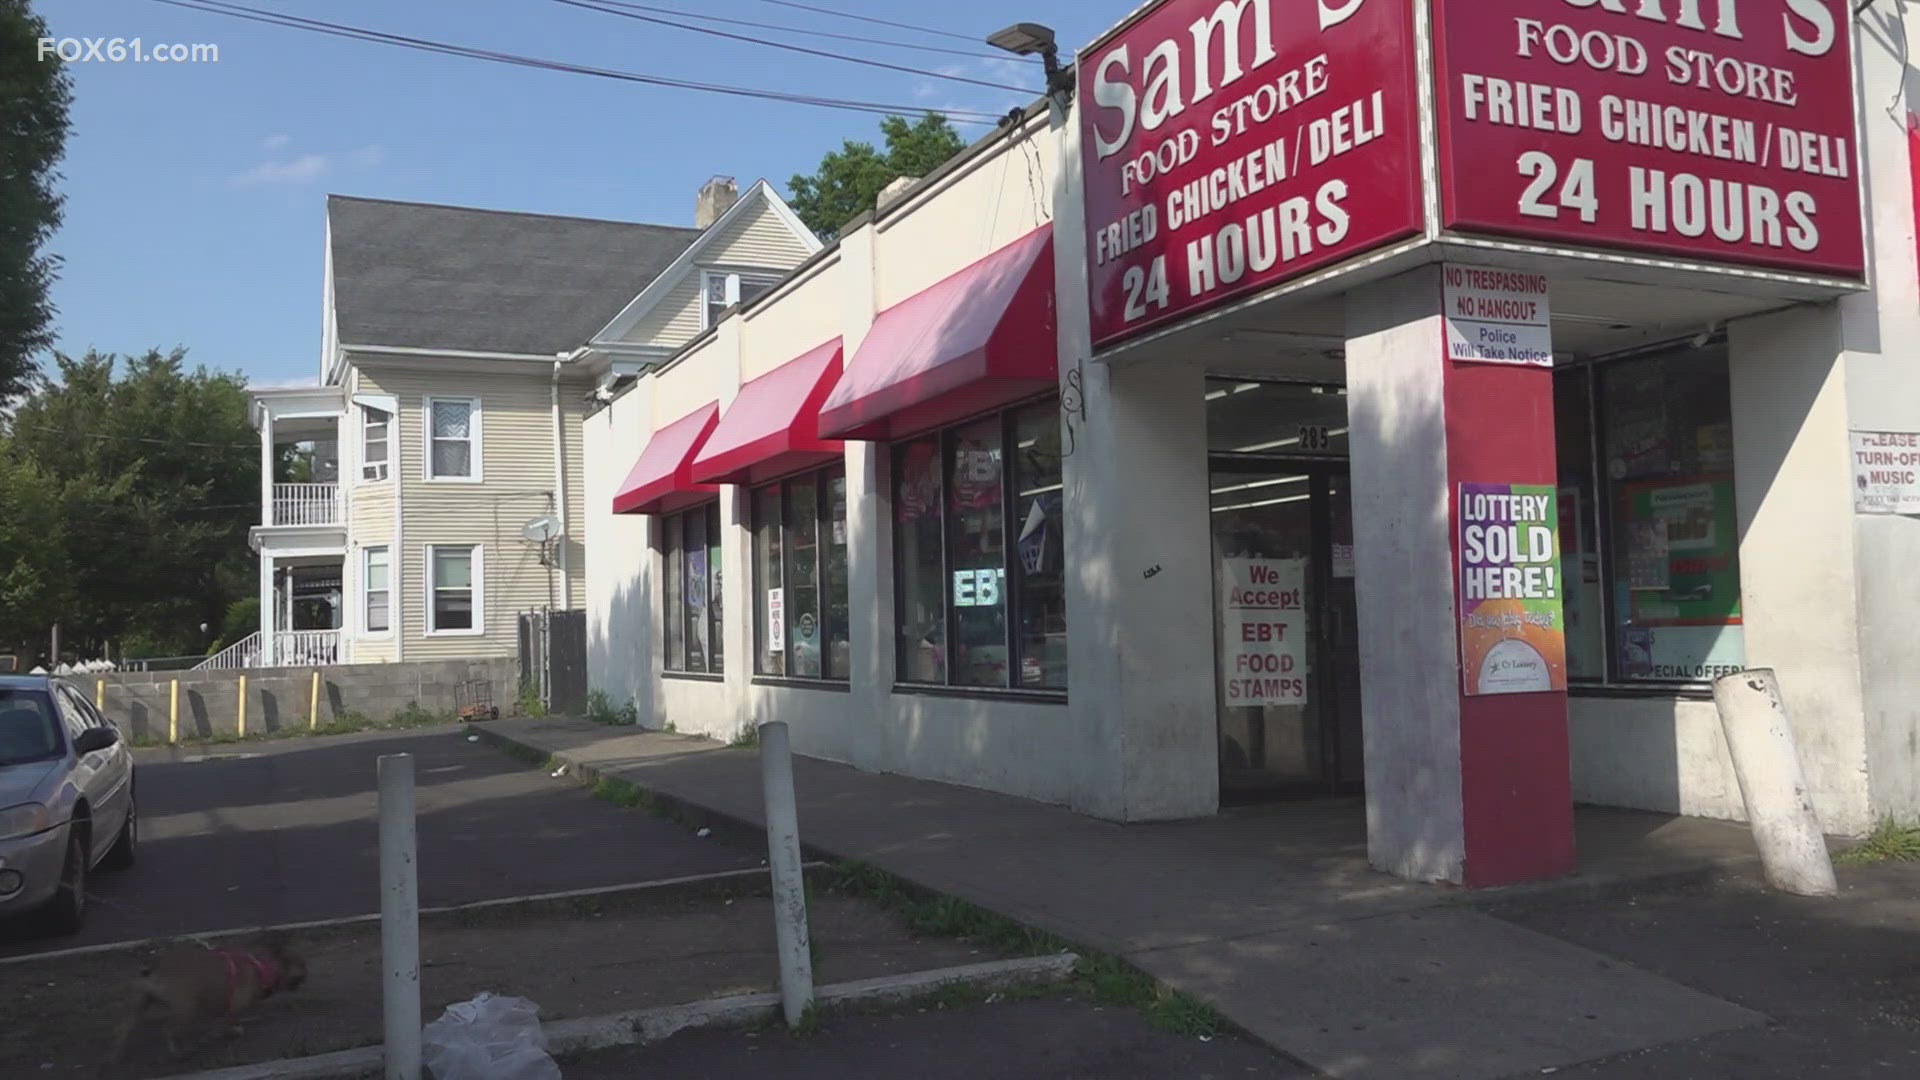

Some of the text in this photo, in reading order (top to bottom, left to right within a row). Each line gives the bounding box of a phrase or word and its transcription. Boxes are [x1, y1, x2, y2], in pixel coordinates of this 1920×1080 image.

[1514, 17, 1648, 76] FOOD
[1665, 46, 1799, 107] STORE
[1093, 0, 1365, 160] Sam
[1462, 73, 1582, 135] FRIED
[1121, 54, 1329, 197] FOOD STORE
[1516, 150, 1819, 252] 24 HOURS
[1097, 203, 1158, 266] FRIED
[1122, 179, 1350, 323] 24 HOURS
[1446, 267, 1547, 294] NO TRESPASSING
[1457, 296, 1474, 316] NO
[1480, 327, 1516, 344] Police
[1453, 342, 1548, 362] Will Take Notice
[1300, 426, 1328, 449] 285
[1855, 451, 1920, 466] TURN-OF
[1870, 471, 1915, 485] MUSIC
[1464, 493, 1549, 521] LOTTERY
[1465, 525, 1553, 564] SOLD
[1249, 565, 1279, 584] We
[1466, 567, 1555, 599] HERE!
[1229, 585, 1300, 609] Accept
[1241, 623, 1288, 642] EBT
[1236, 653, 1294, 673] FOOD
[1229, 678, 1303, 699] STAMPS
